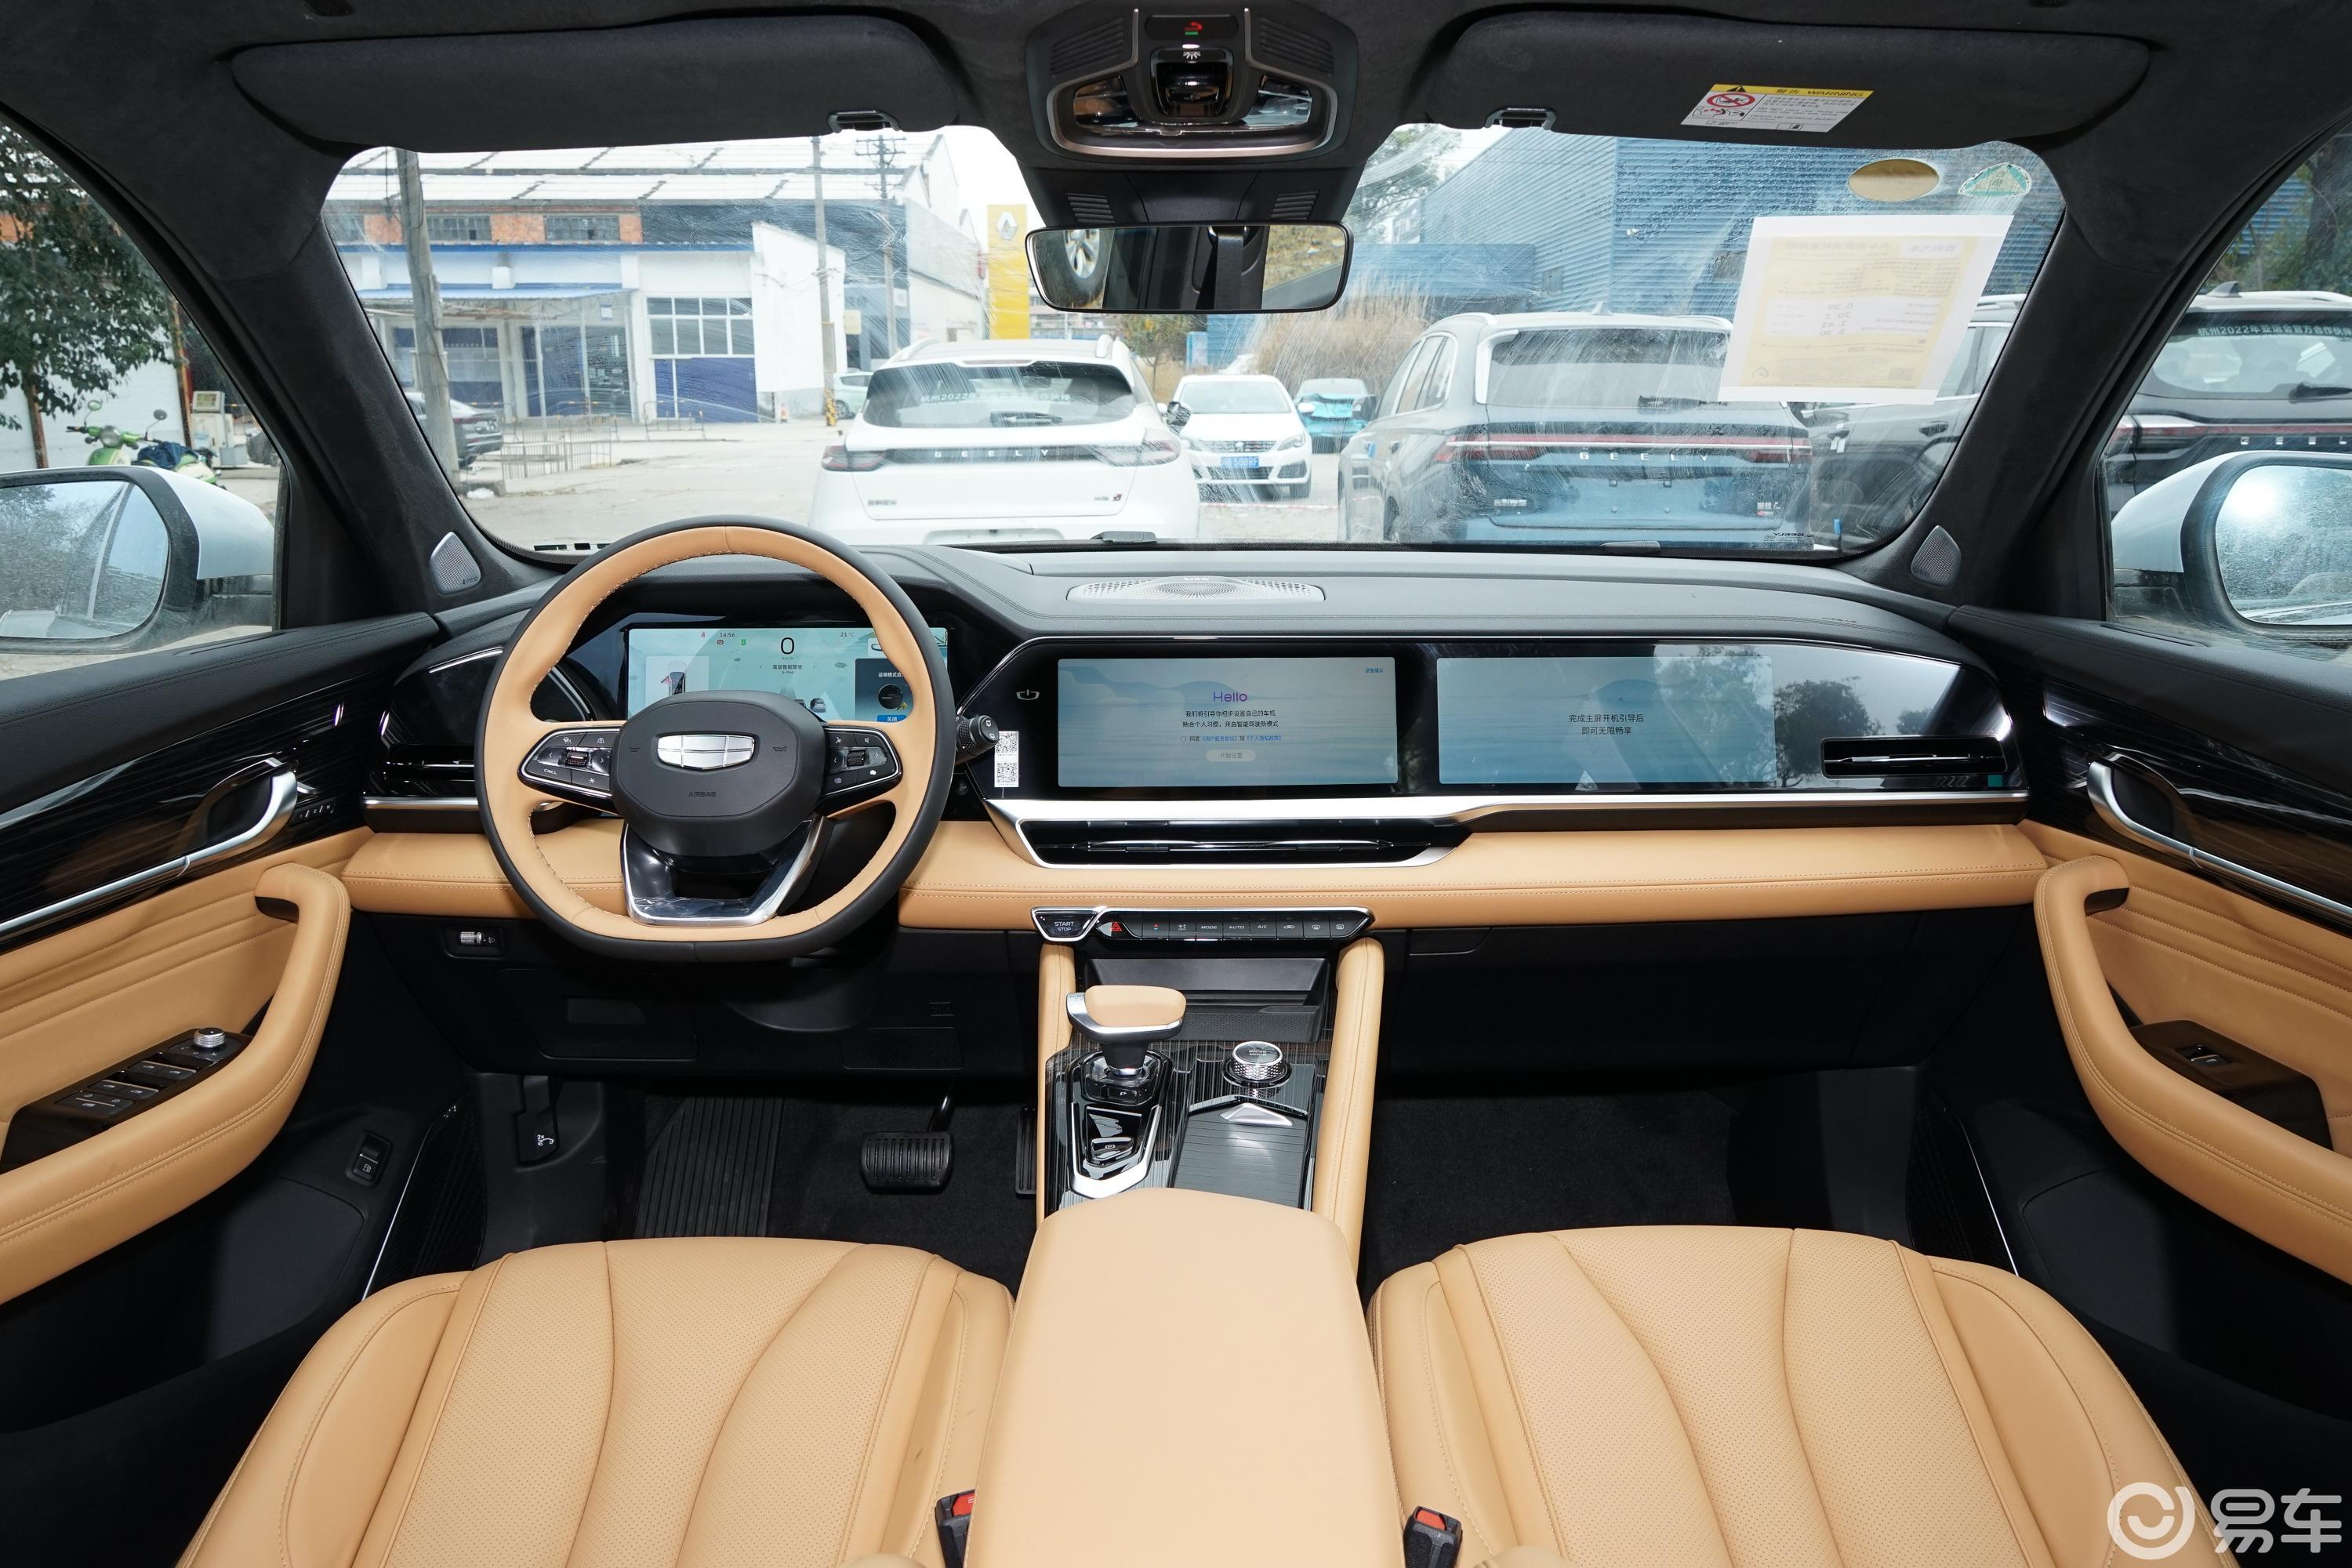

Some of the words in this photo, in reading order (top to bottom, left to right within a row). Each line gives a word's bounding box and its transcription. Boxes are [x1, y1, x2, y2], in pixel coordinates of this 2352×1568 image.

[934, 449, 1049, 458] GEELY
[1579, 452, 1708, 461] GEELY
[780, 637, 795, 655] 0
[1213, 691, 1248, 702] Hello
[1568, 713, 1644, 723] 完成主屏开机引导后
[1581, 726, 1632, 735] 即可无限畅享
